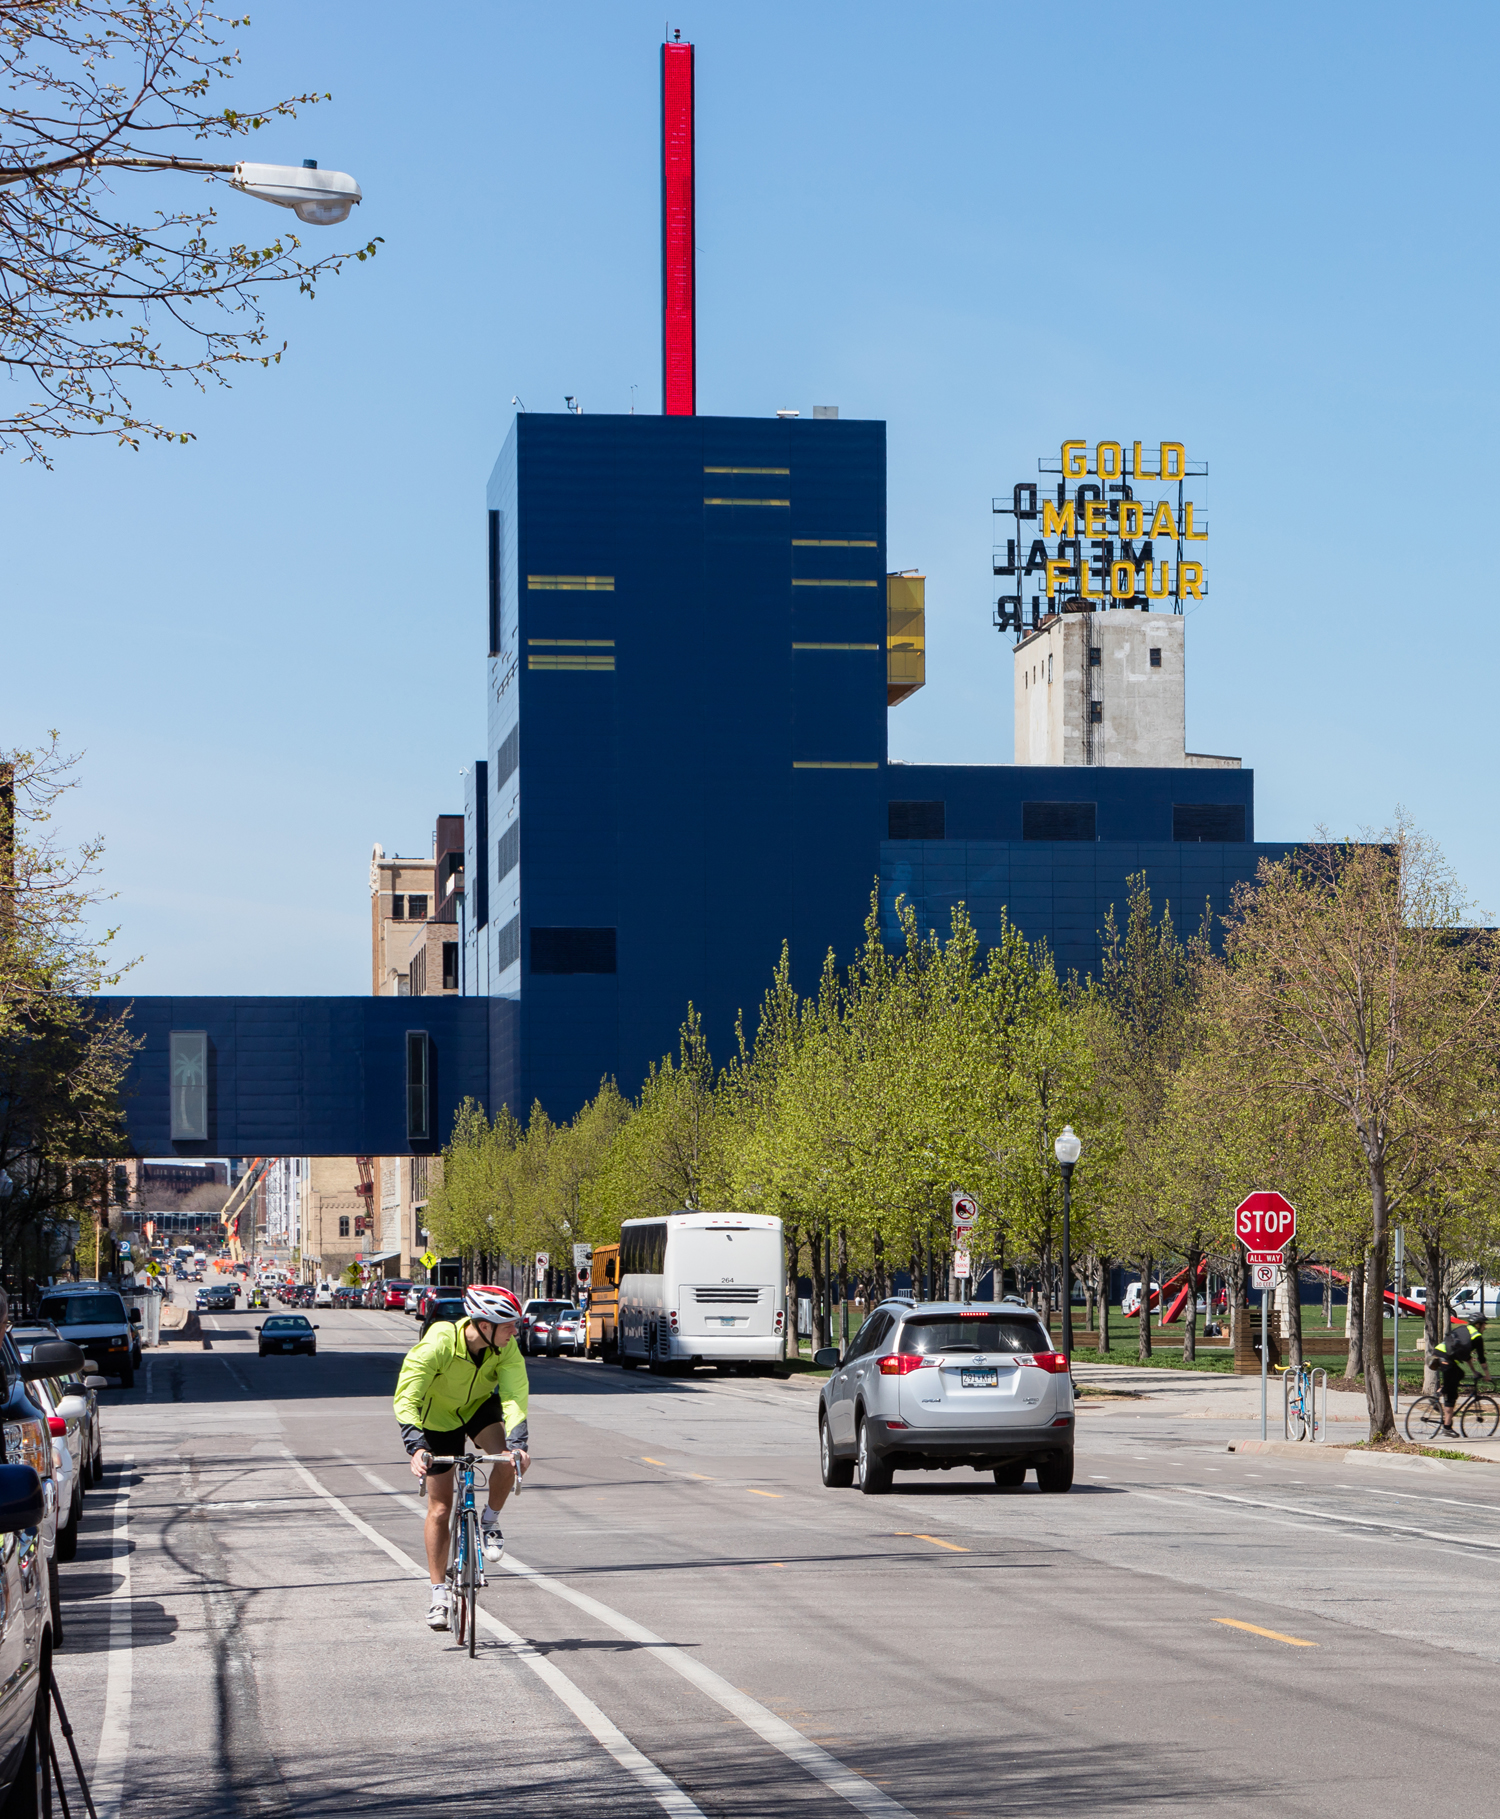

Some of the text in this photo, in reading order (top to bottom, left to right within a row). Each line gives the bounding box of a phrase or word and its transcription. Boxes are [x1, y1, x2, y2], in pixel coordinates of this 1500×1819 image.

[1061, 440, 1186, 480] GOLD
[1042, 499, 1208, 540] MEDAL
[1045, 559, 1204, 600] FLOUR
[1239, 1211, 1291, 1233] STOP
[963, 1373, 995, 1383] 291 KFF
